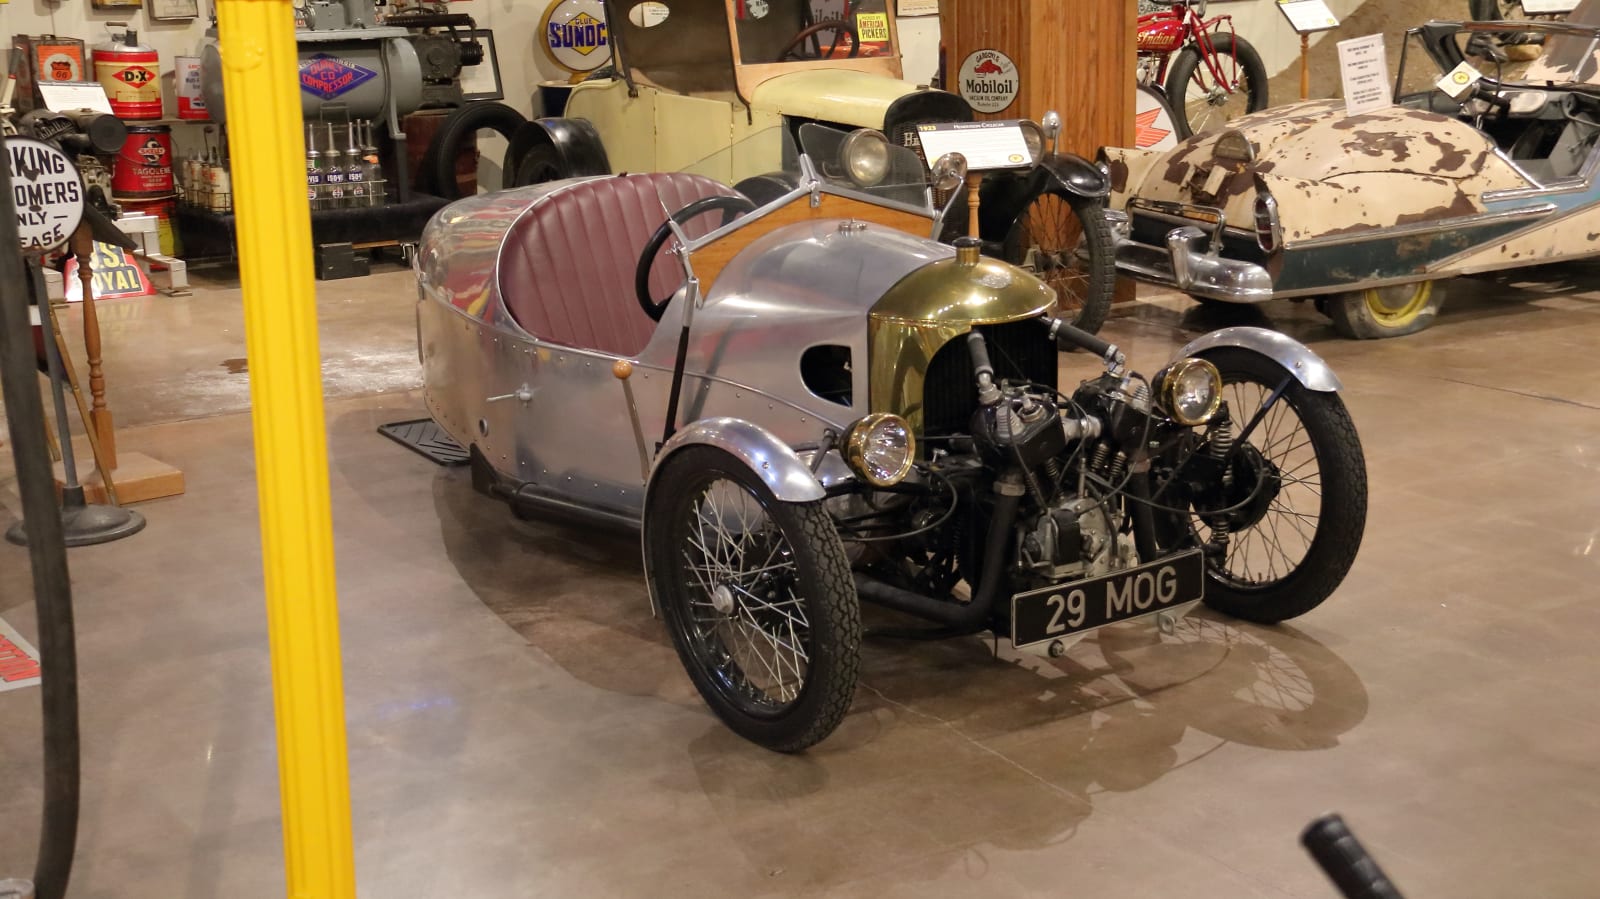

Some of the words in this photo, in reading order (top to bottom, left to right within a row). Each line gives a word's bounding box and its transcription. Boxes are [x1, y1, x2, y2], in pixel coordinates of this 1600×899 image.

[859, 20, 884, 29] AMERICAN
[550, 22, 607, 48] SUNOC
[861, 28, 887, 39] PICKERS
[56, 70, 68, 79] 66
[302, 71, 353, 93] COMPRESSOR
[966, 79, 1013, 94] Mobiloil
[14, 181, 79, 207] OMERS
[16, 211, 48, 226] NLY
[1045, 589, 1087, 635] 29
[1105, 565, 1178, 620] MOG
